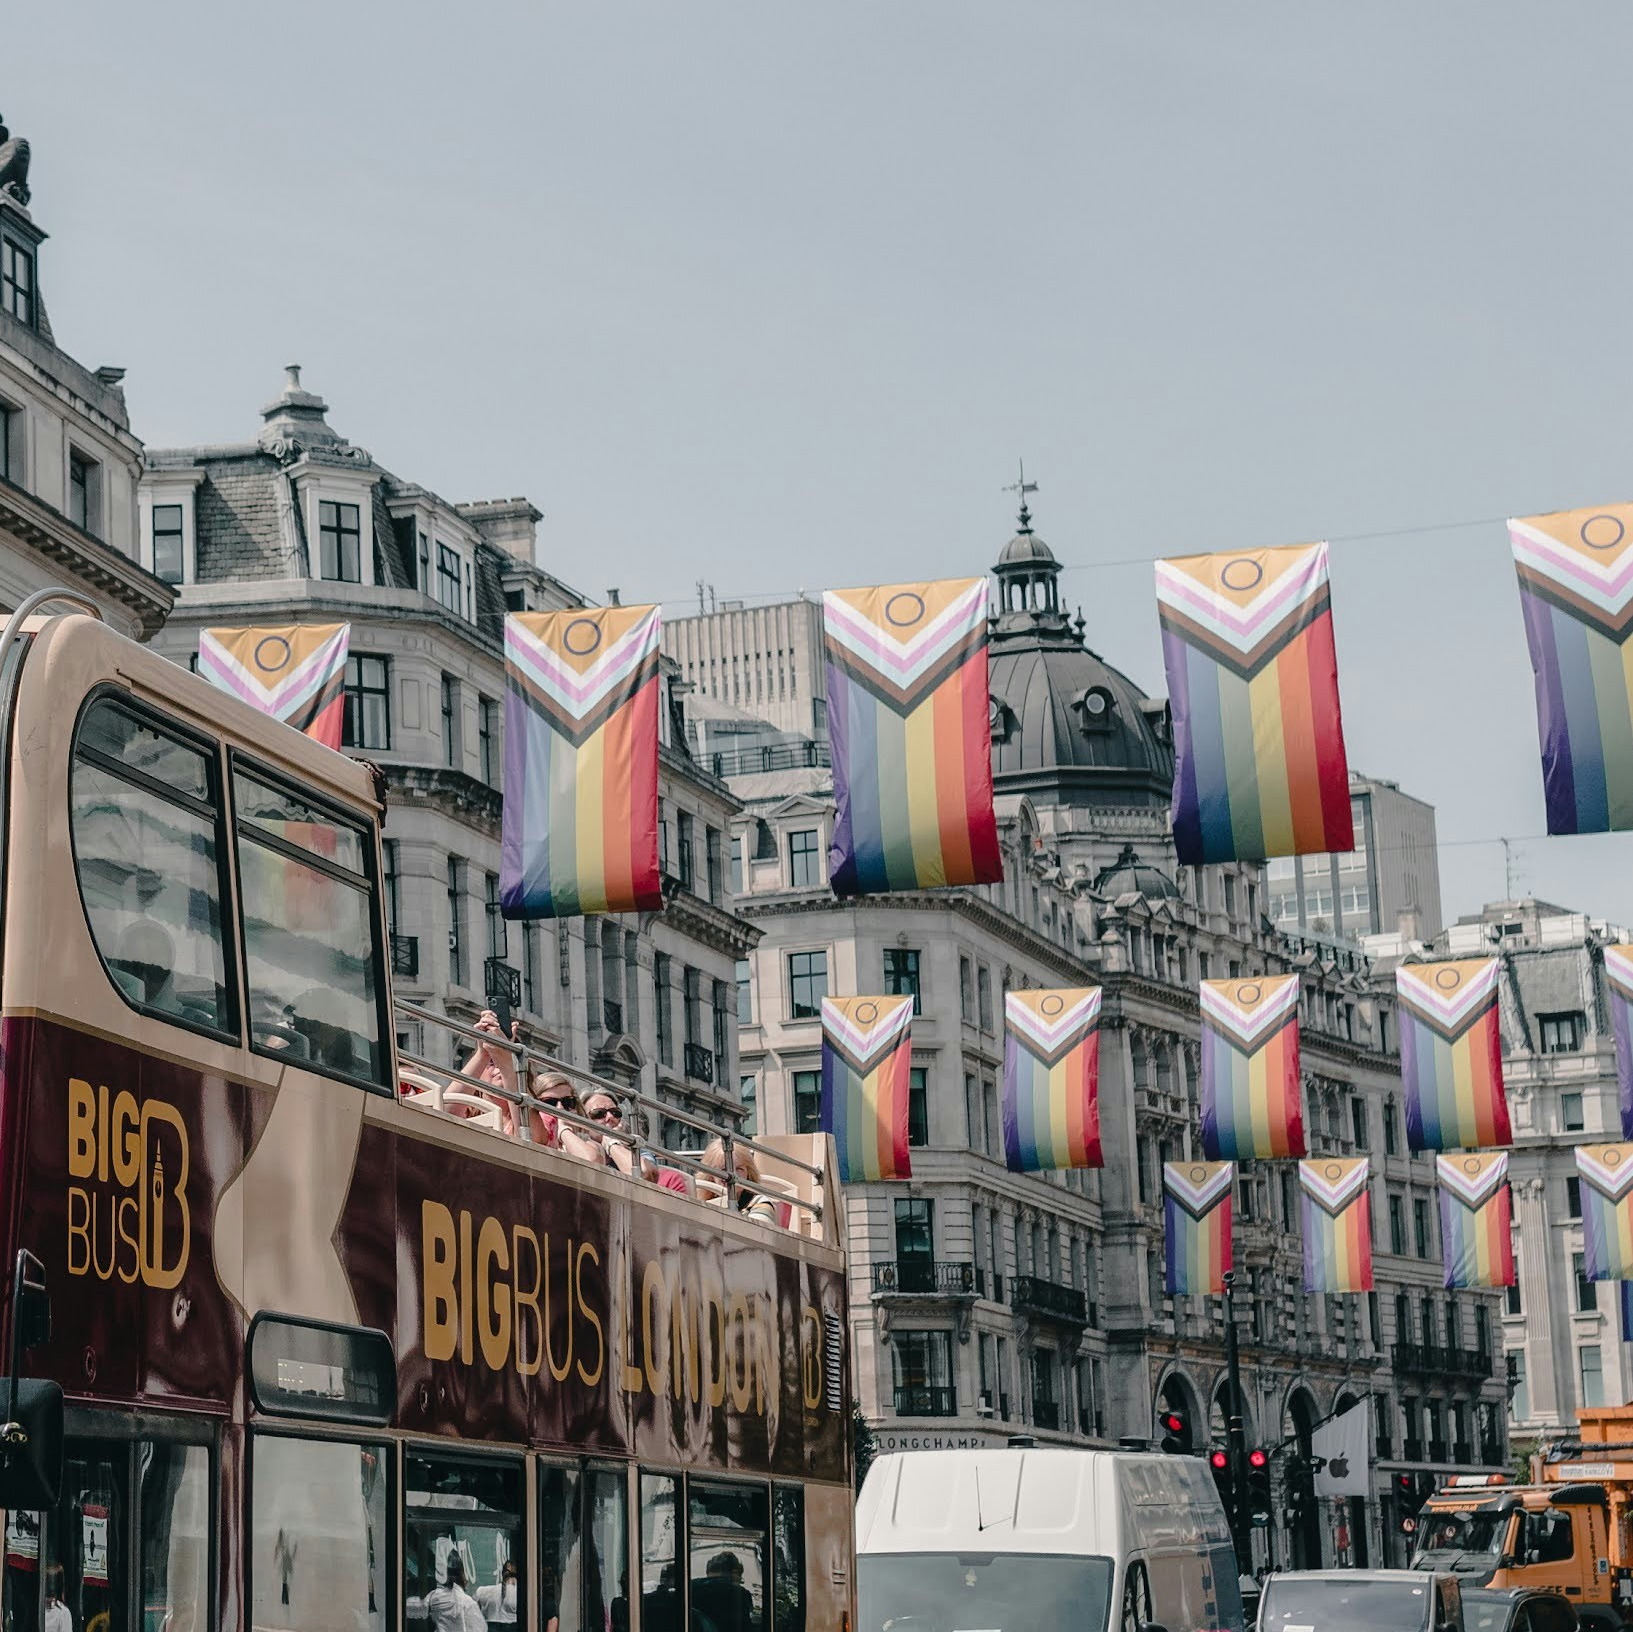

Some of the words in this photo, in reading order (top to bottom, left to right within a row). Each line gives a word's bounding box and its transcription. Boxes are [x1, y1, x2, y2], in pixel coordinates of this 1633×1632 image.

[69, 1078, 140, 1187] BIG
[69, 1187, 139, 1284] BUS
[620, 1252, 780, 1417] LONDON
[878, 1437, 978, 1448] LONGCHAMP
